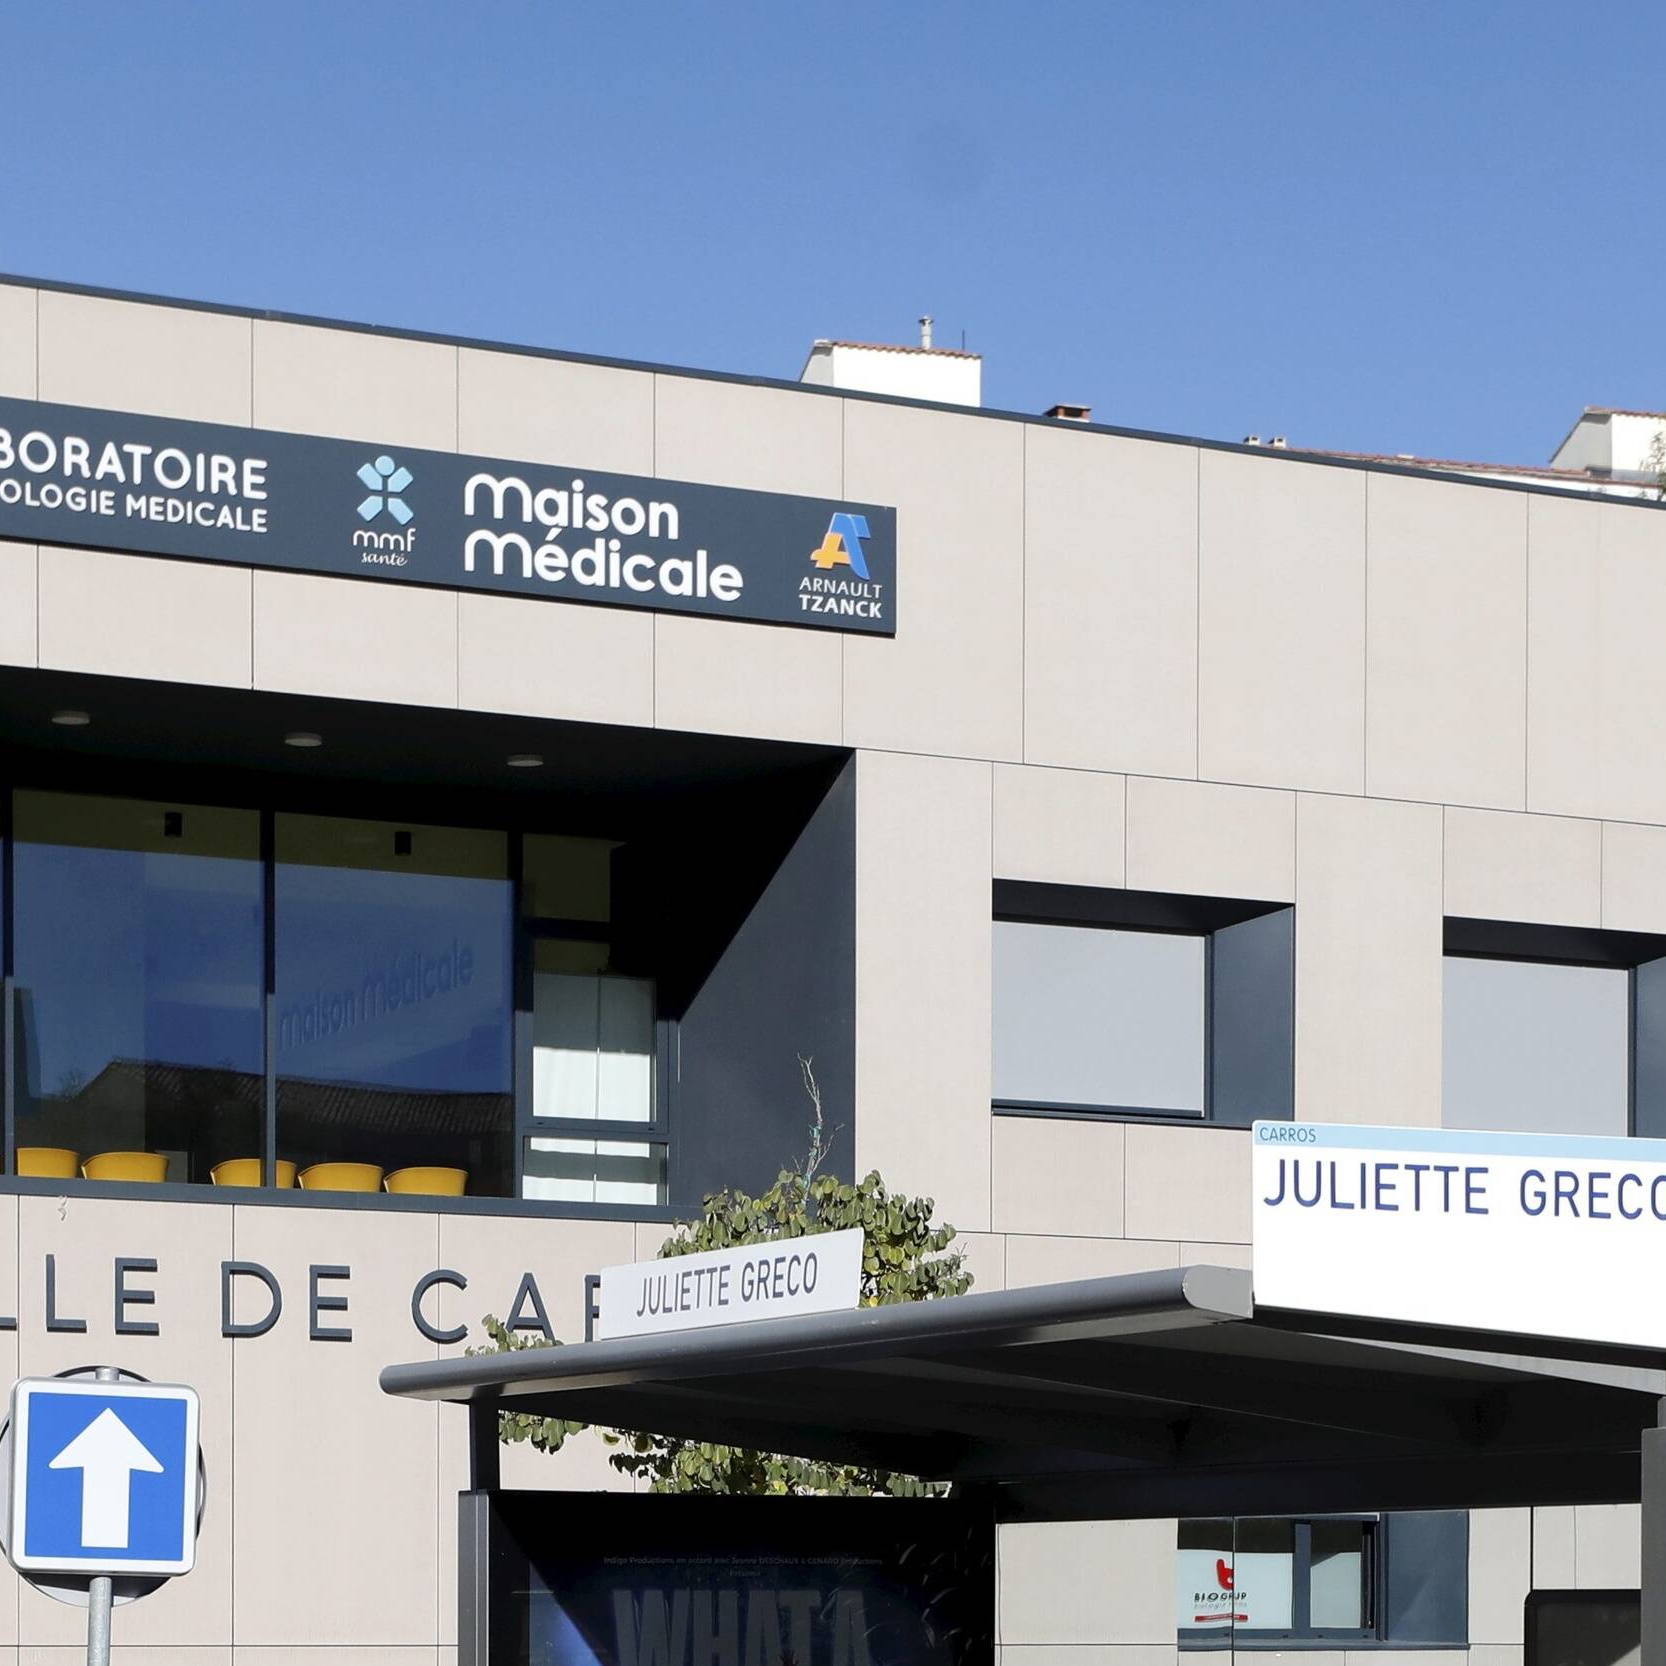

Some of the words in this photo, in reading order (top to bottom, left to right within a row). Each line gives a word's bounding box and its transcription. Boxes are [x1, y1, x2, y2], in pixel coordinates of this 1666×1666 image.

[126, 494, 268, 533] MEDICALE
[464, 473, 679, 540] maison
[353, 528, 416, 552] mmf
[361, 552, 407, 567] santé
[464, 528, 744, 602] médicale
[799, 576, 883, 600] ARNAULT
[799, 594, 883, 619] TZANCK
[1259, 1127, 1317, 1143] CARROS
[1263, 1158, 1489, 1216] JULIETTE
[221, 1261, 352, 1342] DE
[636, 1265, 731, 1317] JULIETTE
[741, 1252, 818, 1303] GRECO
